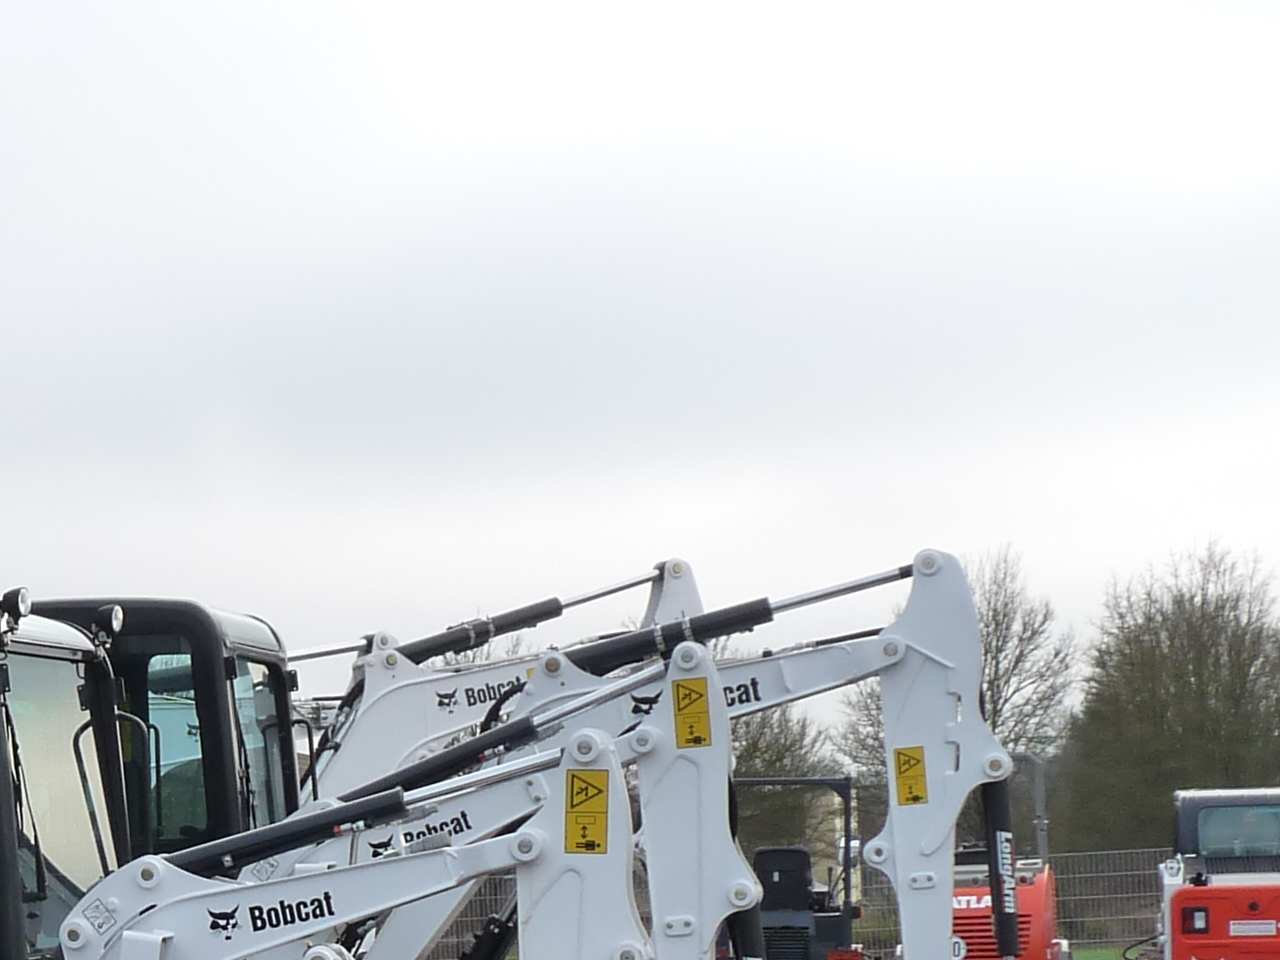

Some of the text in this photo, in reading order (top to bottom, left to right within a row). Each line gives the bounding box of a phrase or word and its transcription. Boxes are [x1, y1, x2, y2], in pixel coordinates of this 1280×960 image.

[723, 677, 762, 707] cat
[997, 830, 1016, 913] LongArm
[248, 891, 335, 932] Bobcat
[952, 894, 992, 909] ATLA
